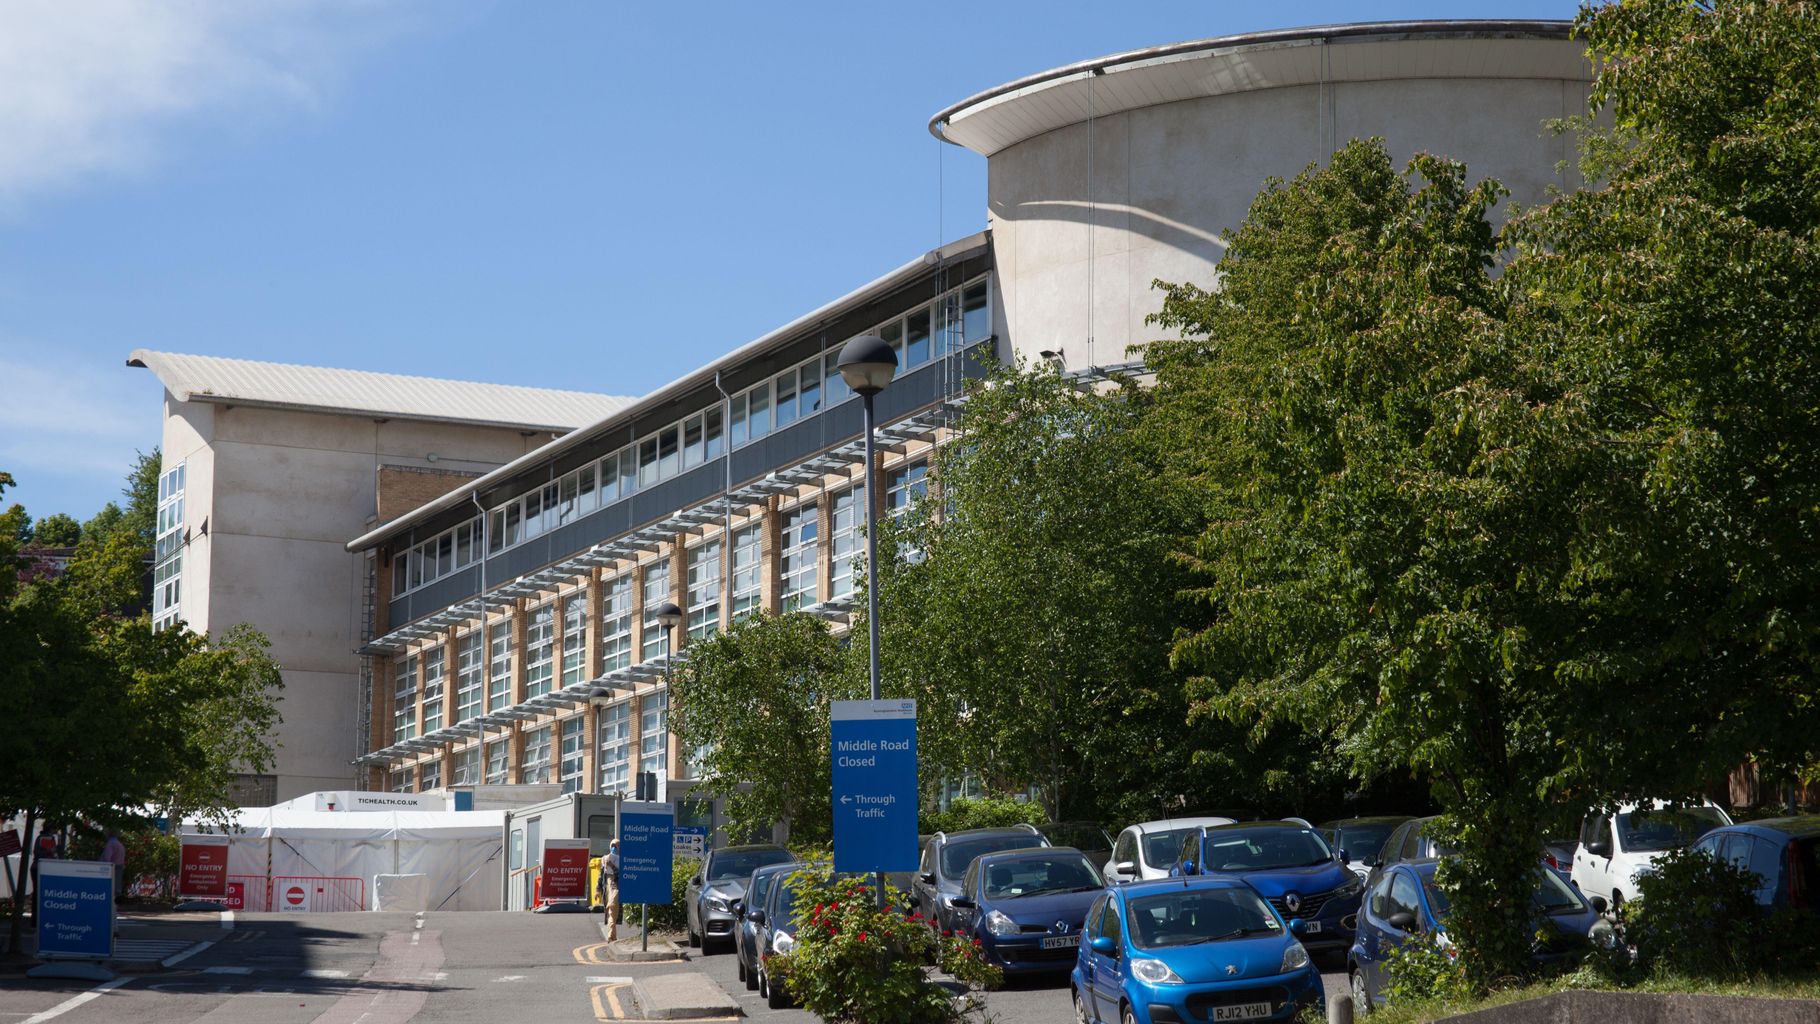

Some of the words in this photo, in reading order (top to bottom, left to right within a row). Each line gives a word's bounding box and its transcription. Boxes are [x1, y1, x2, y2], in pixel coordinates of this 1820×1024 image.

[838, 740, 877, 751] Middle
[881, 739, 909, 750] Road
[838, 756, 875, 767] Closed
[855, 795, 895, 806] Through
[856, 808, 885, 818] Traffic
[624, 825, 649, 833] Middle
[44, 889, 78, 900] Middle
[80, 891, 106, 901] Road
[44, 900, 76, 910] Closed
[57, 923, 92, 933] Through
[57, 932, 82, 941] Traffic
[1044, 937, 1067, 948] HV57
[1216, 1006, 1242, 1020] RJ12
[1244, 1004, 1267, 1017] YHU
